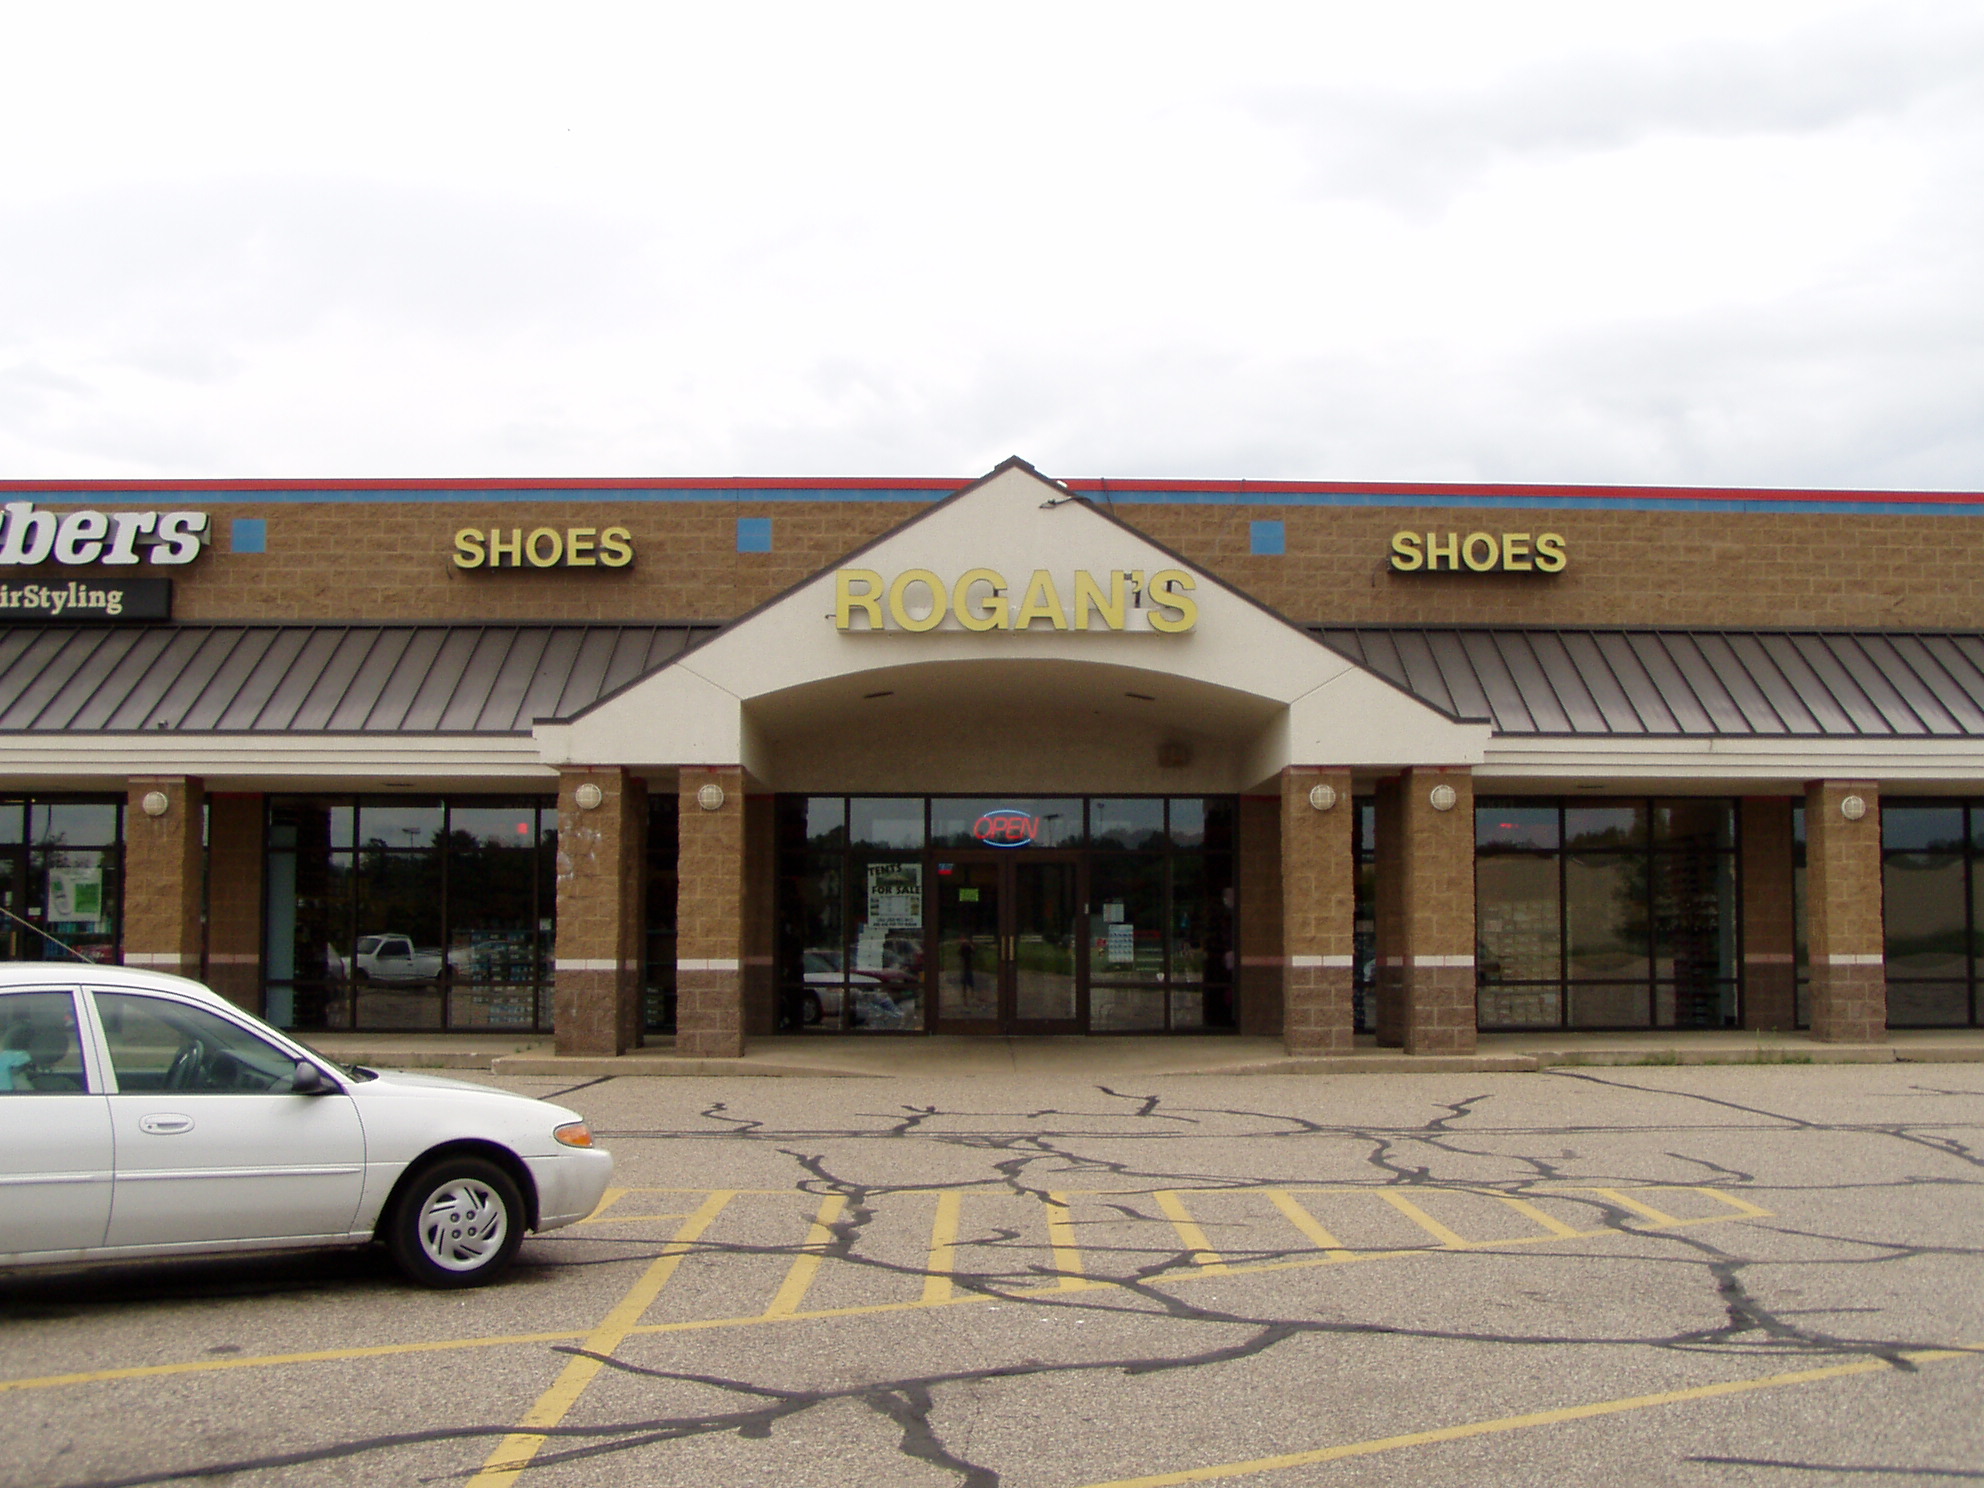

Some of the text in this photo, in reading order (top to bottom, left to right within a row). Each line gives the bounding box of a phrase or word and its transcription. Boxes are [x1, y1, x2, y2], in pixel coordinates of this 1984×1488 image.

[0, 501, 207, 565] bers
[453, 527, 633, 568] SHOES
[1391, 531, 1567, 572] SHOES
[835, 568, 1197, 632] ROGAN'S
[974, 816, 1040, 839] OPEN
[868, 863, 902, 876] TENTS
[872, 886, 921, 894] FOR SALE
